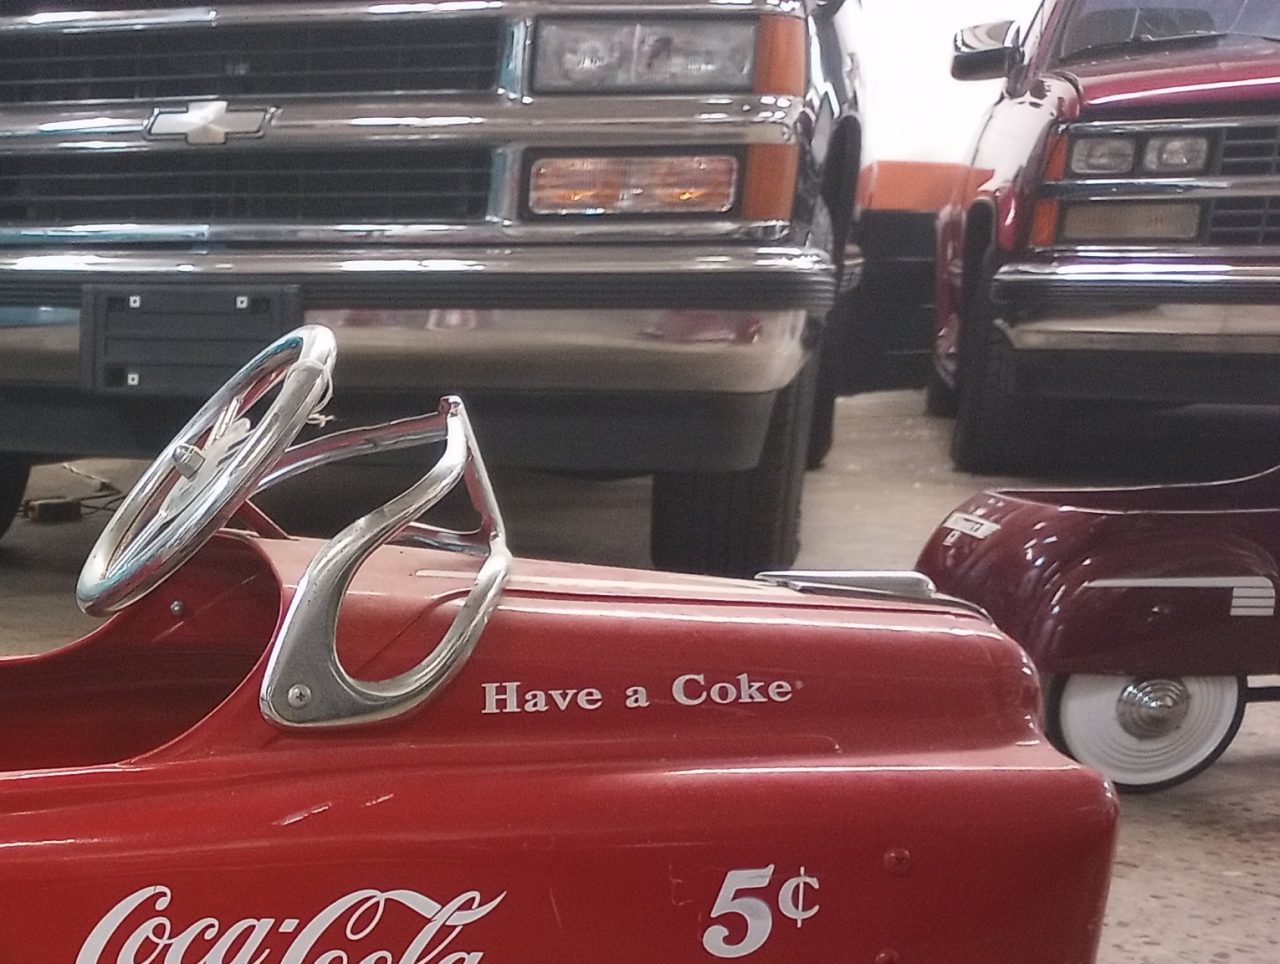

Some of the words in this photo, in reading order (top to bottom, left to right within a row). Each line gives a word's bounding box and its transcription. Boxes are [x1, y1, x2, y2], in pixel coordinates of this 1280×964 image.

[481, 681, 603, 714] Have
[624, 685, 649, 708] a
[672, 673, 793, 706] Coke
[703, 864, 820, 959] 5¢
